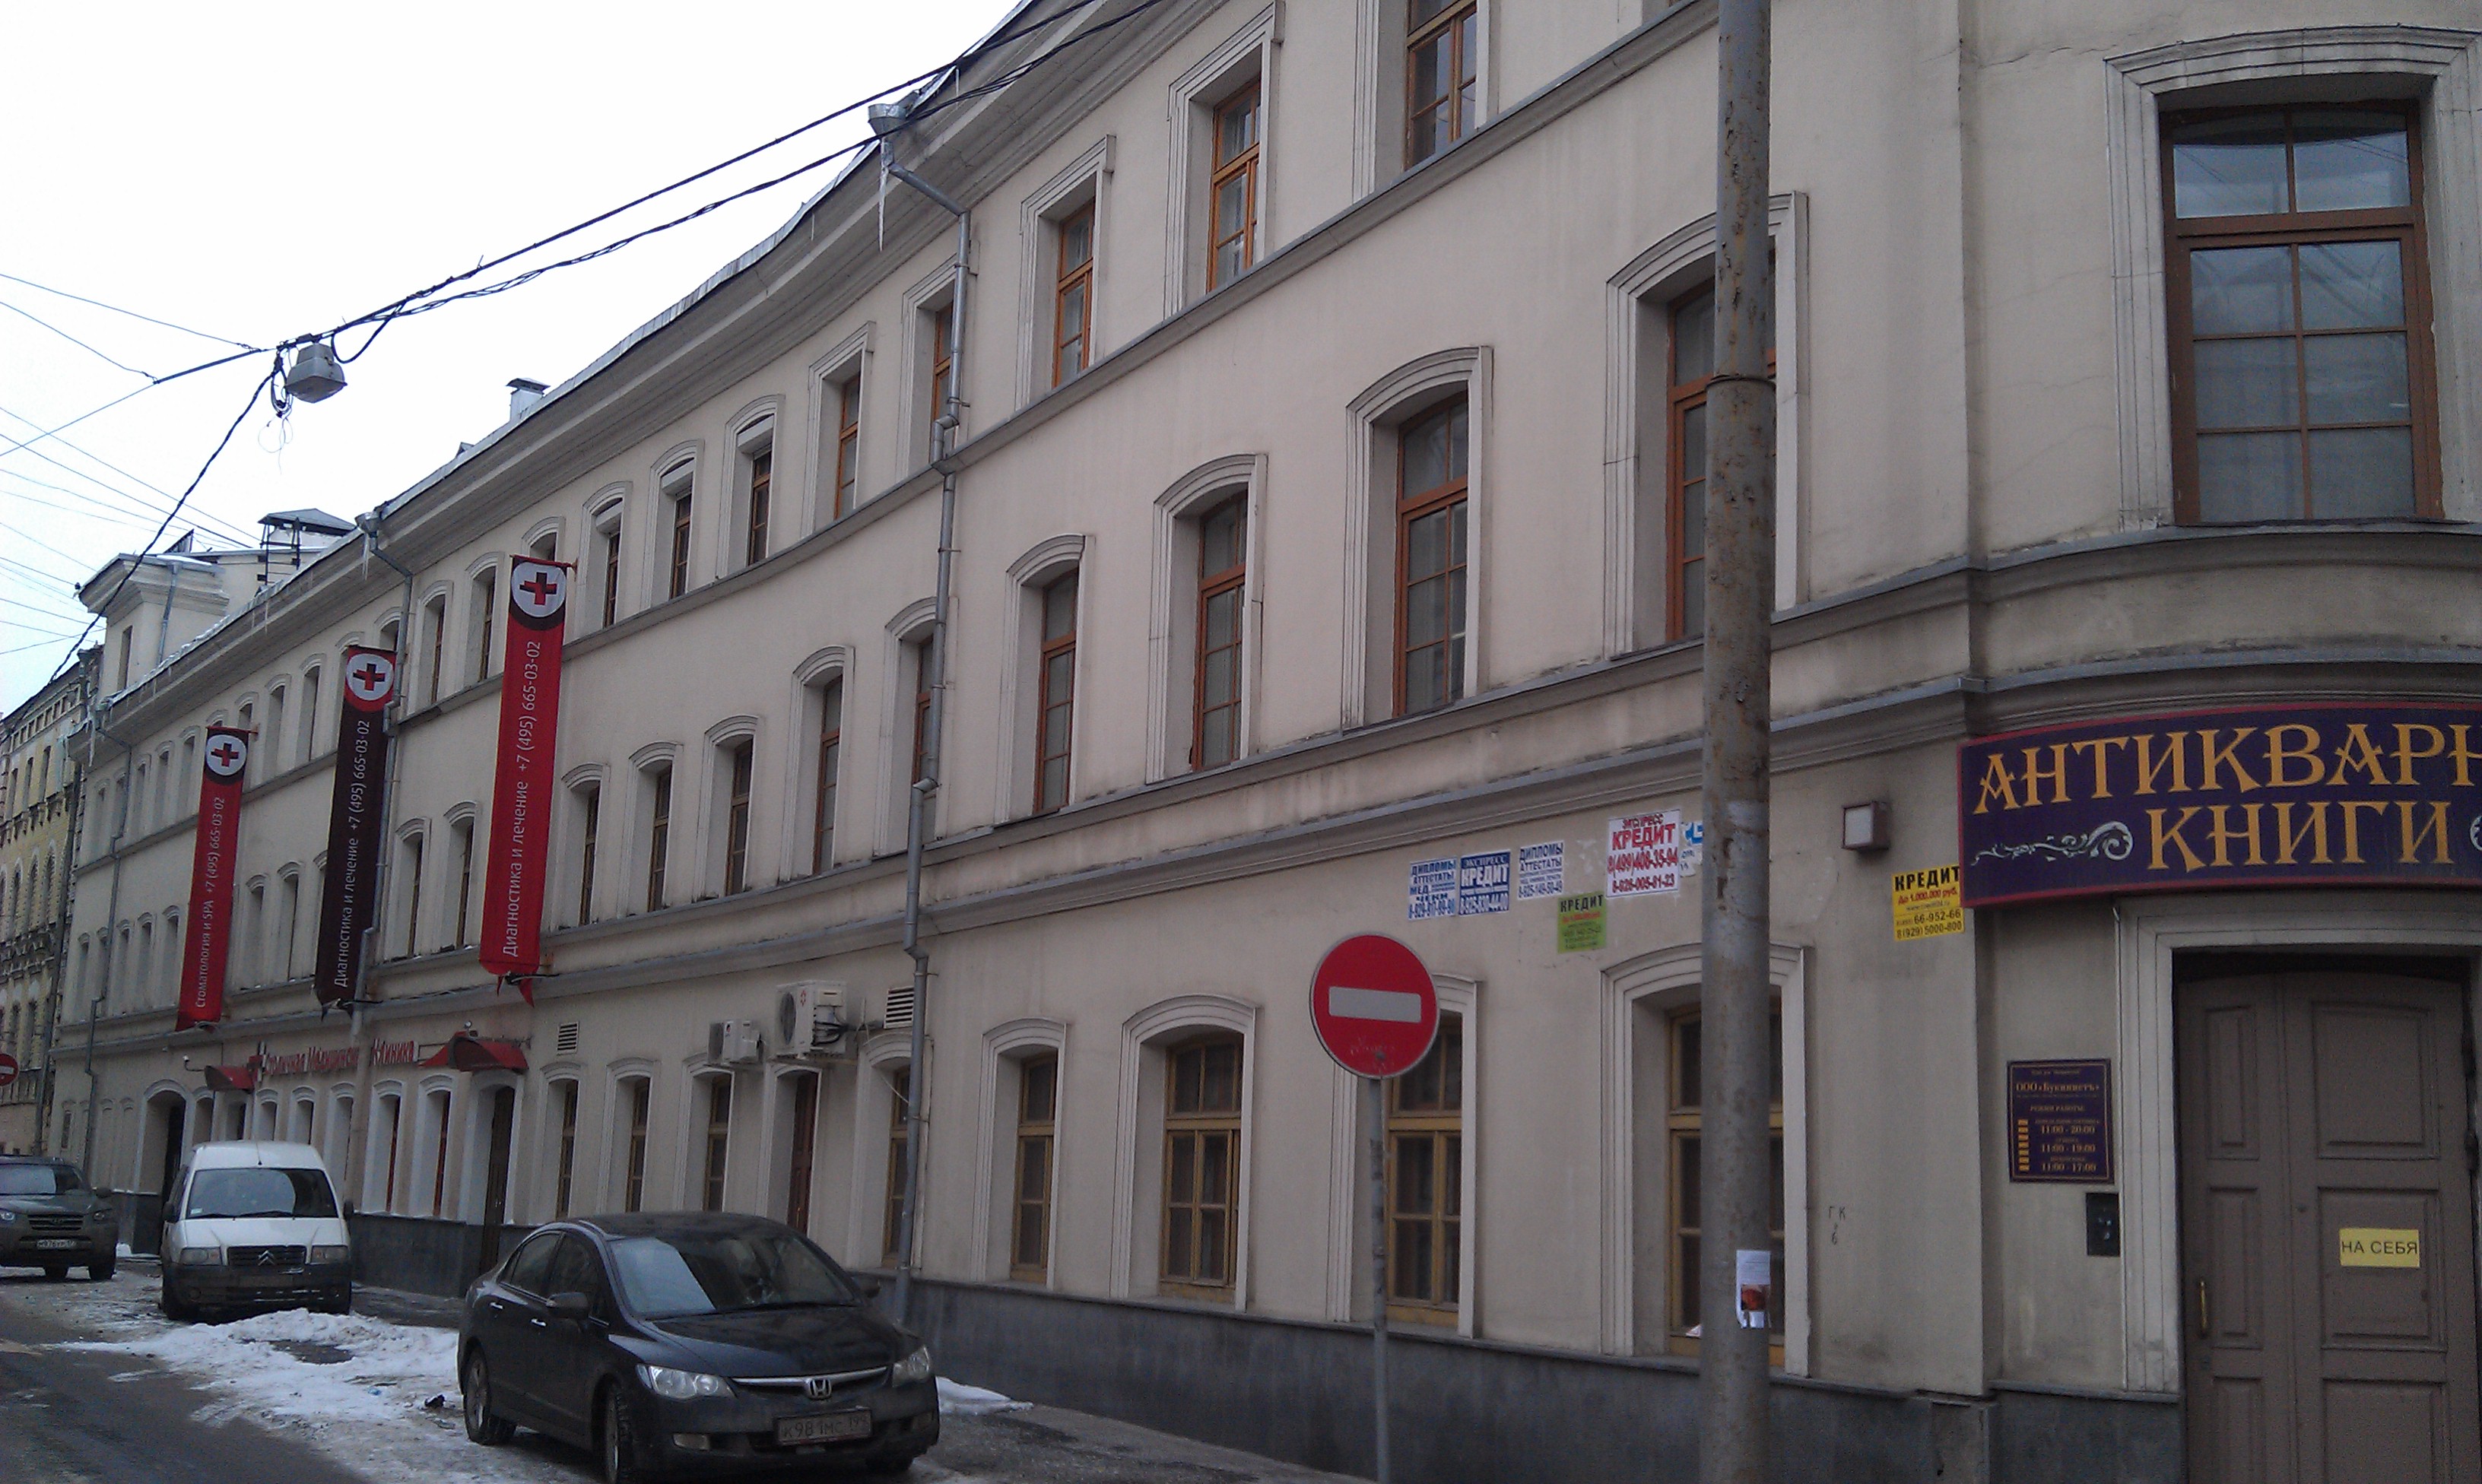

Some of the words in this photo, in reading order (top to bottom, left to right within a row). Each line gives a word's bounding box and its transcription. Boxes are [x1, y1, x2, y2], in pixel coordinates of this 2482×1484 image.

[522, 641, 541, 712] 665-03-02
[517, 716, 537, 751] (495)
[357, 720, 370, 779] 665-03-02
[516, 755, 531, 772] +7
[348, 783, 367, 813] (495)
[211, 797, 225, 850] 665-03-02
[348, 817, 361, 831] +7
[512, 782, 528, 845] лечение
[1612, 823, 1676, 850] КРЕДИТ
[2146, 801, 2455, 873] КНИГИ
[511, 848, 523, 858] и
[1519, 842, 1563, 861] ДИПЛОМЫ
[1520, 857, 1562, 872] АТТЕСТАТЫ
[206, 852, 221, 879] (495)
[344, 838, 359, 893] лечение
[1411, 859, 1456, 876] ДИПЛОМЫ
[1413, 870, 1455, 884] АТТЕСТАТЫ
[1461, 864, 1509, 887] КРЕДИТ
[1894, 866, 1960, 892] КРЕДИТ
[203, 900, 214, 919] SPA
[344, 895, 354, 905] и
[503, 863, 522, 957] Диагностика
[1560, 894, 1603, 912] КРЕДИТ
[1914, 908, 1961, 924] 66-952-66
[335, 907, 352, 988] Диагностика
[195, 934, 211, 1008] Стоматология
[2341, 1241, 2365, 1254] НА
[2370, 1241, 2418, 1254] СЕБЯ
